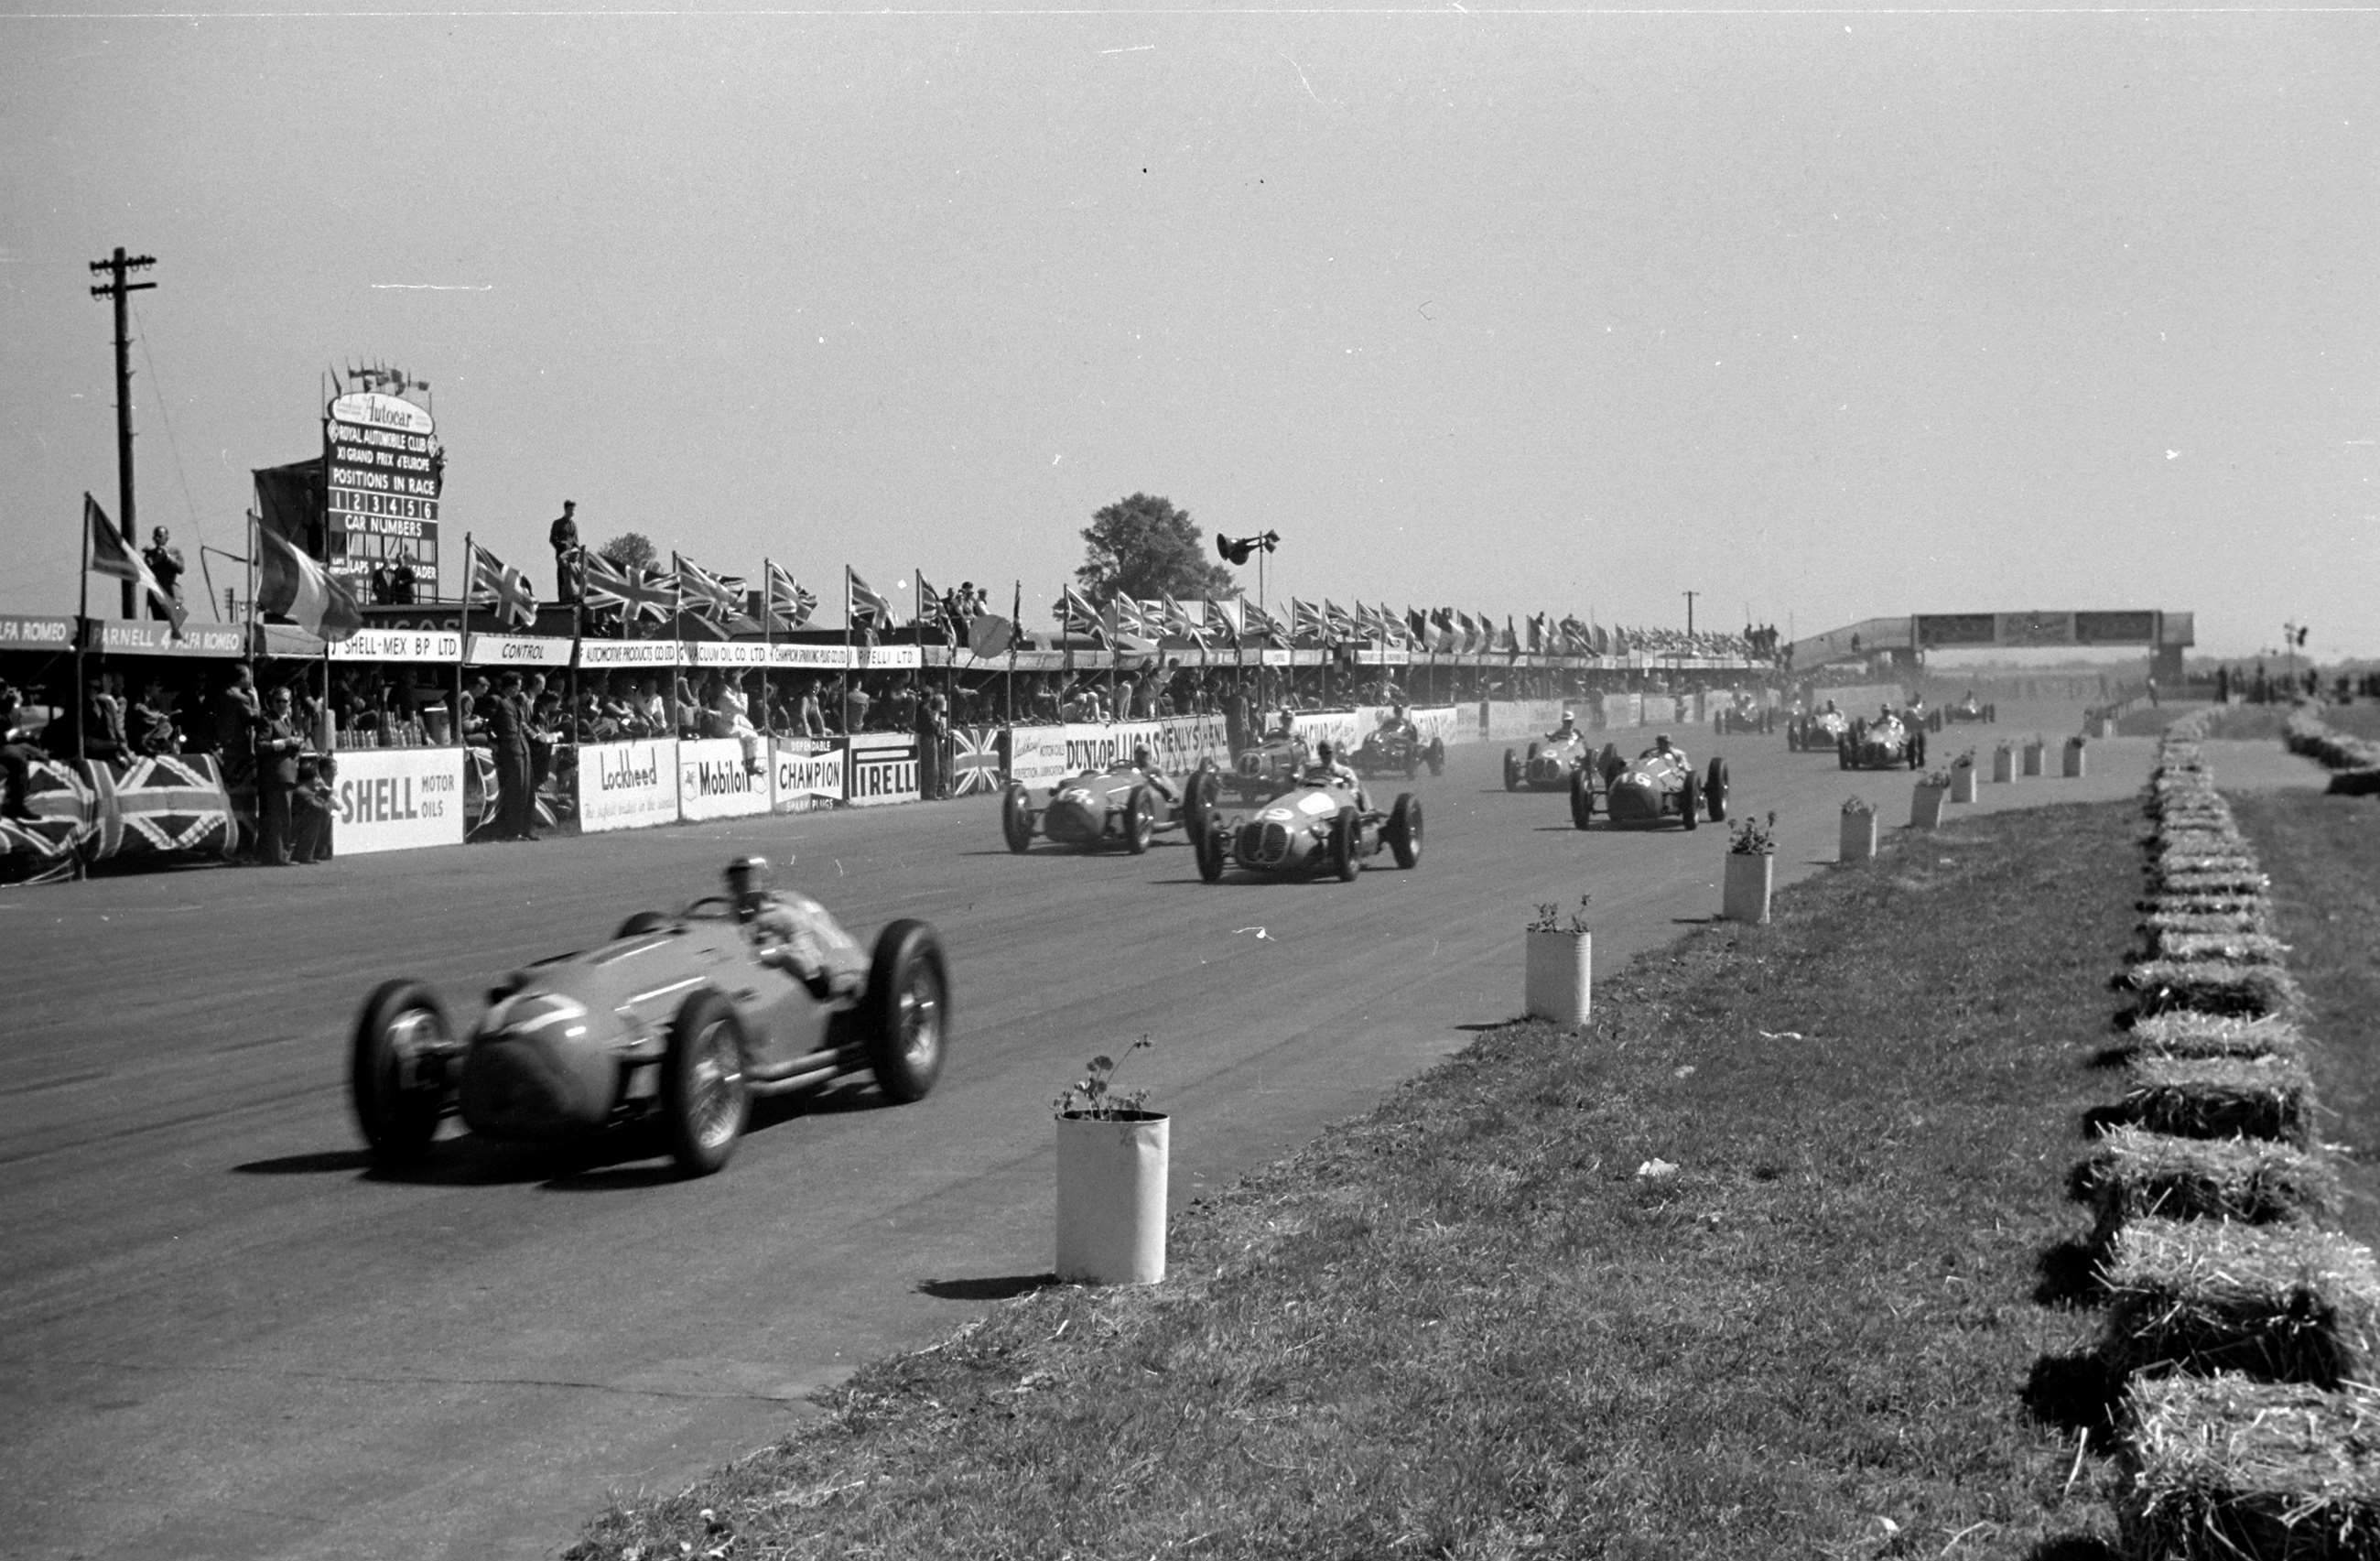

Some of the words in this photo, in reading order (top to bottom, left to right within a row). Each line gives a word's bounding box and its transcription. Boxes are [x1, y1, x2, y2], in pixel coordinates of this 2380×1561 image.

[365, 396, 412, 428] Autocar
[339, 424, 362, 443] ROYAL
[363, 428, 406, 450] AUTOMOBILE
[407, 435, 427, 452] CLUB
[347, 448, 374, 464] GRAND
[376, 451, 394, 467] PRIX
[332, 468, 389, 489] POSITIONS
[393, 475, 406, 491] IN
[408, 478, 435, 495] RACE
[336, 492, 341, 508] 1
[353, 493, 361, 511] 2
[373, 495, 380, 513] 3
[389, 498, 397, 515] 4
[407, 501, 415, 516] 5
[424, 503, 432, 519] 6
[345, 514, 365, 531] CAR
[370, 517, 423, 537] NUMBERS
[22, 622, 67, 642] ROMEO
[92, 627, 154, 647] PARNELL
[202, 631, 240, 651] ROMEO
[415, 637, 430, 656] BP
[502, 643, 545, 659] CONTROL
[688, 646, 719, 661] VACUUM
[1066, 739, 1115, 770] DUNLOP
[600, 746, 657, 791] Lockheed
[779, 761, 840, 789] CHAMPION
[851, 744, 919, 798] PIRELLI
[420, 775, 455, 793] MOTOR
[341, 777, 417, 824] SHELL
[421, 800, 444, 818] OILS
